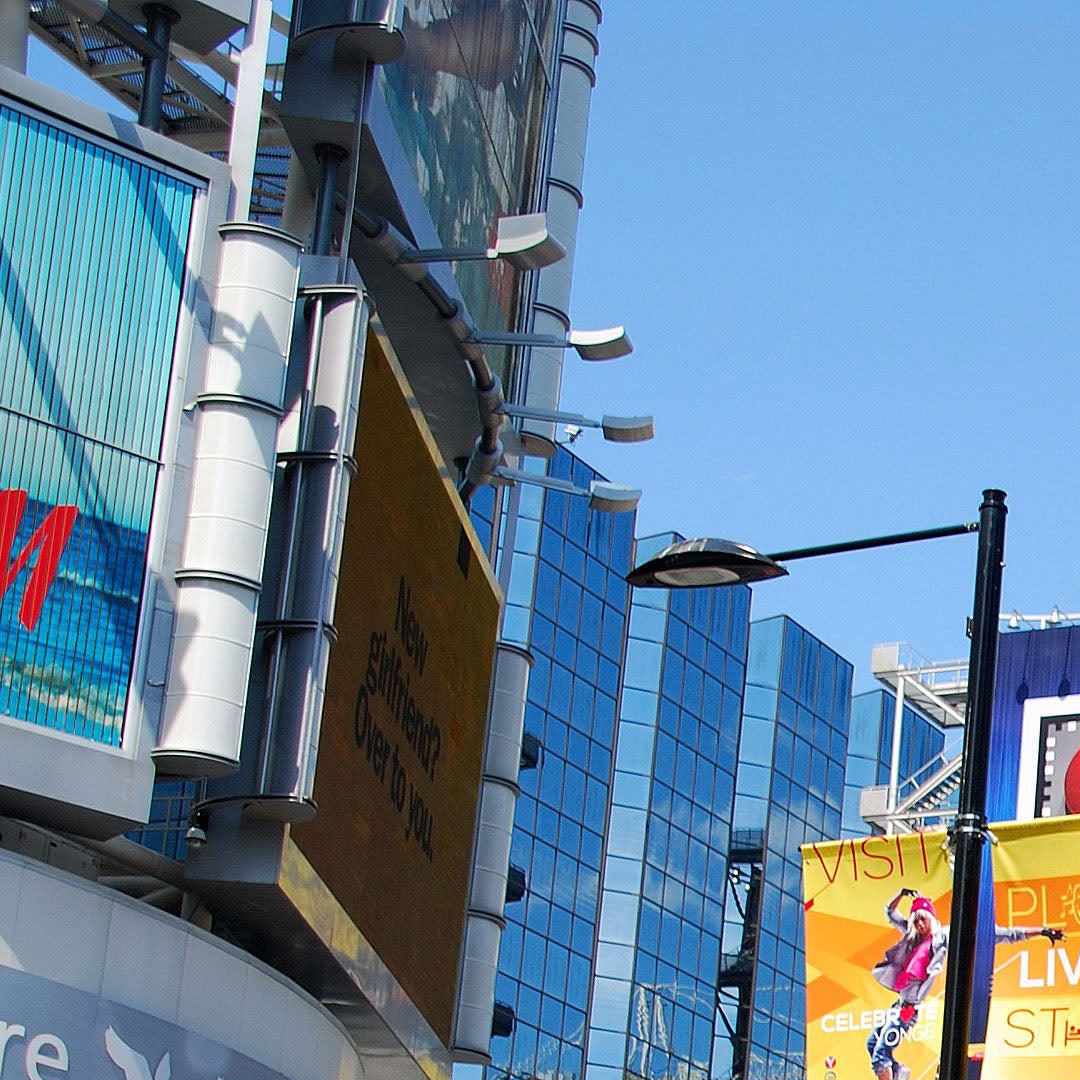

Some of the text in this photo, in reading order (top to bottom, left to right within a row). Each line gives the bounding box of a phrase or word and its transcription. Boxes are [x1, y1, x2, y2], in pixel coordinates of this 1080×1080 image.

[394, 574, 429, 677] New
[353, 683, 391, 785] Over
[388, 743, 406, 814] to
[812, 828, 935, 884] VISIT
[820, 1001, 939, 1033] CELEBRTE
[873, 1025, 935, 1049] YONGE
